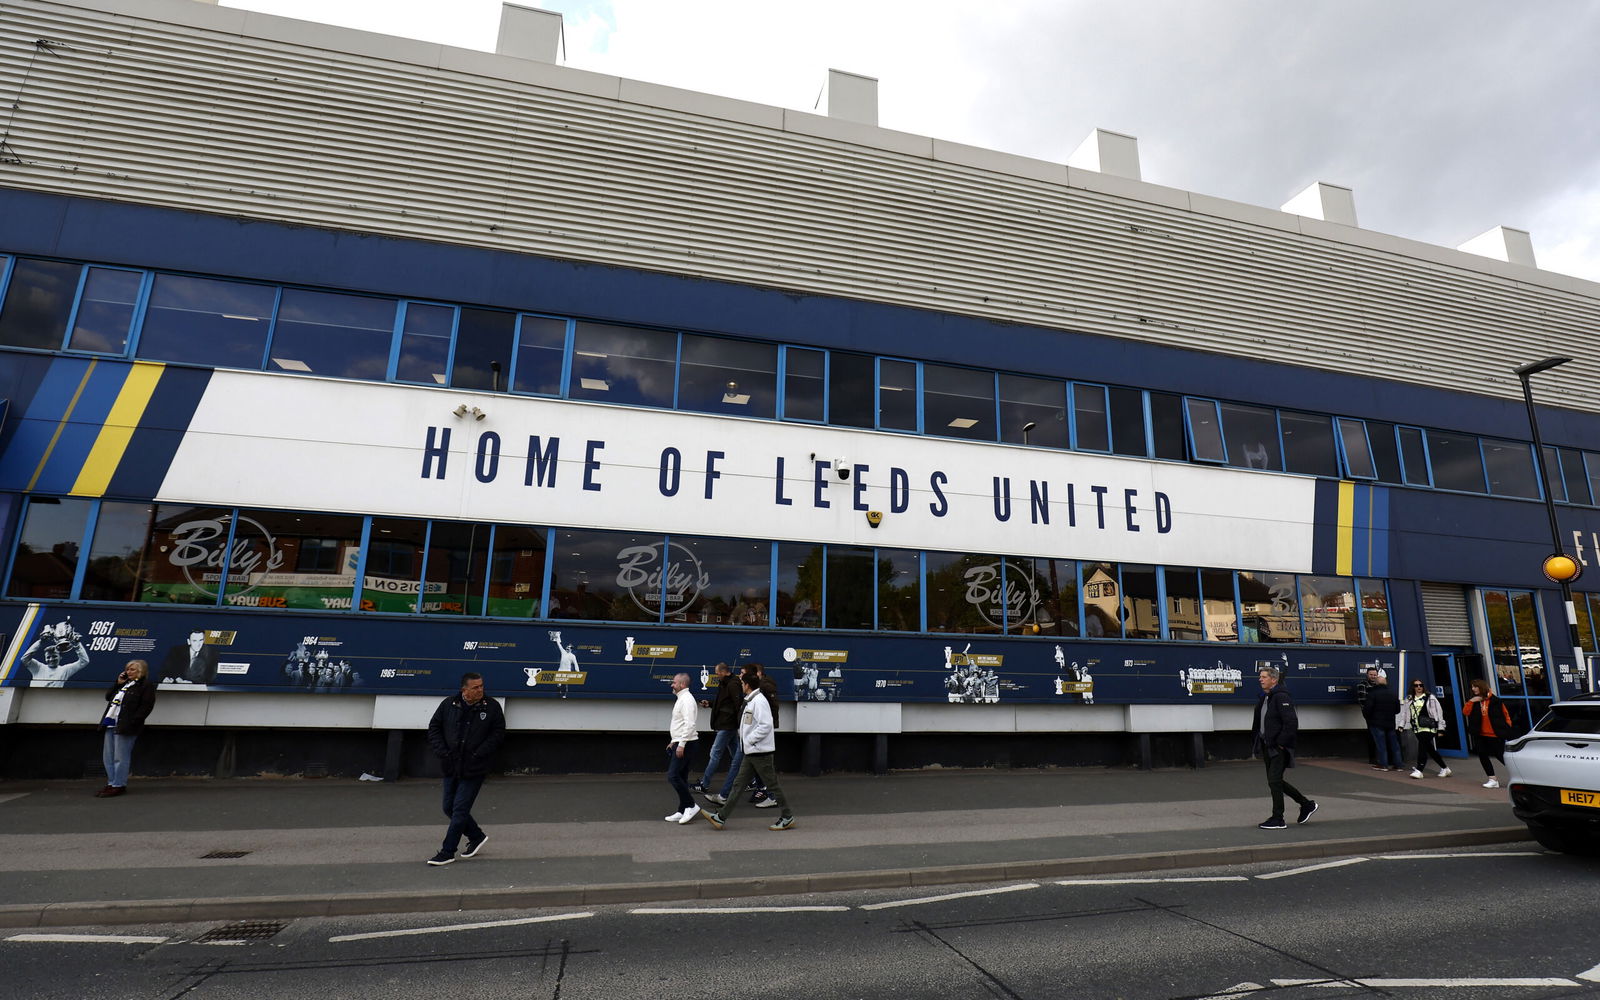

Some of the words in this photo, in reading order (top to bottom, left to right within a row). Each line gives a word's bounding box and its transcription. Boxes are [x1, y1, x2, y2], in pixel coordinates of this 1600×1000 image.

[421, 426, 605, 492] HOME
[658, 446, 725, 500] OF
[775, 456, 948, 518] LEEDS
[993, 476, 1172, 534] UNITED
[169, 519, 284, 576] Billy's
[616, 545, 711, 595] Billy's
[88, 621, 115, 636] 1961
[86, 637, 118, 651] -1980
[302, 636, 318, 646] 1964
[463, 641, 479, 650] 1967
[380, 668, 396, 678] 1965
[1568, 792, 1595, 804] HE17
